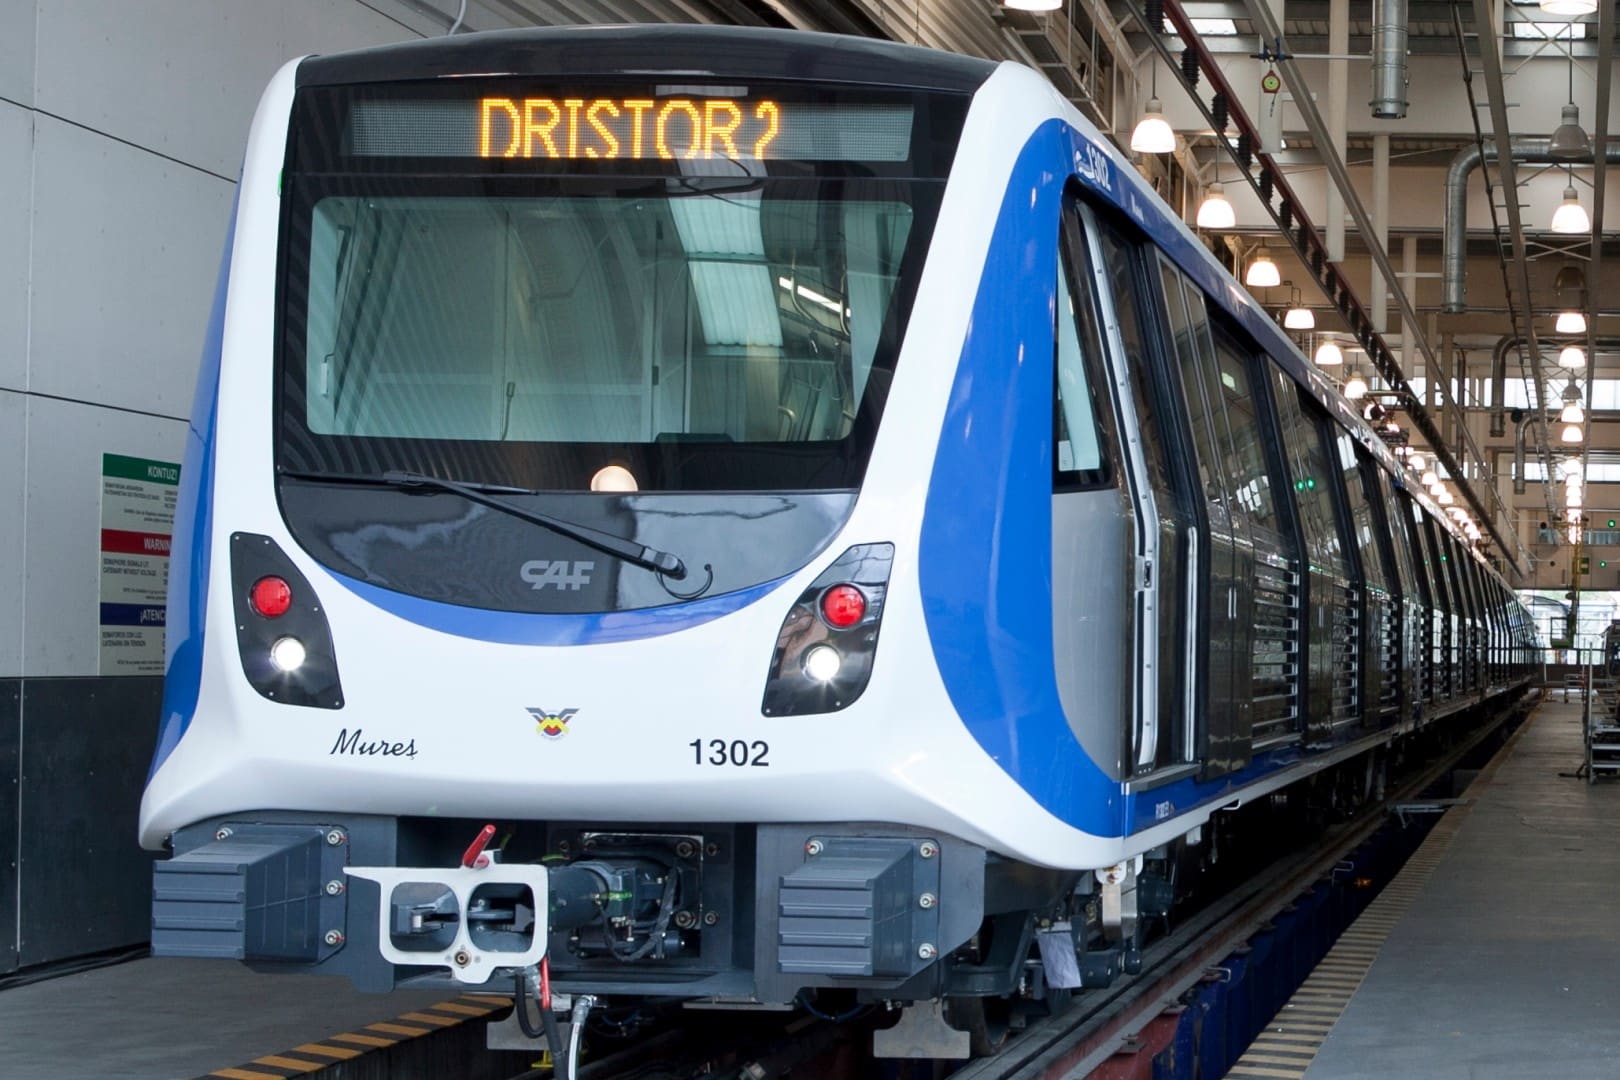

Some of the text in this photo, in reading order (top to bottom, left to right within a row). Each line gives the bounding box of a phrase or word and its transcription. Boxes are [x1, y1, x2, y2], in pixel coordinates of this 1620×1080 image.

[479, 98, 743, 159] DRISTOR
[1086, 143, 1112, 192] 1302
[519, 559, 595, 591] CAF
[688, 738, 770, 767] 1302
